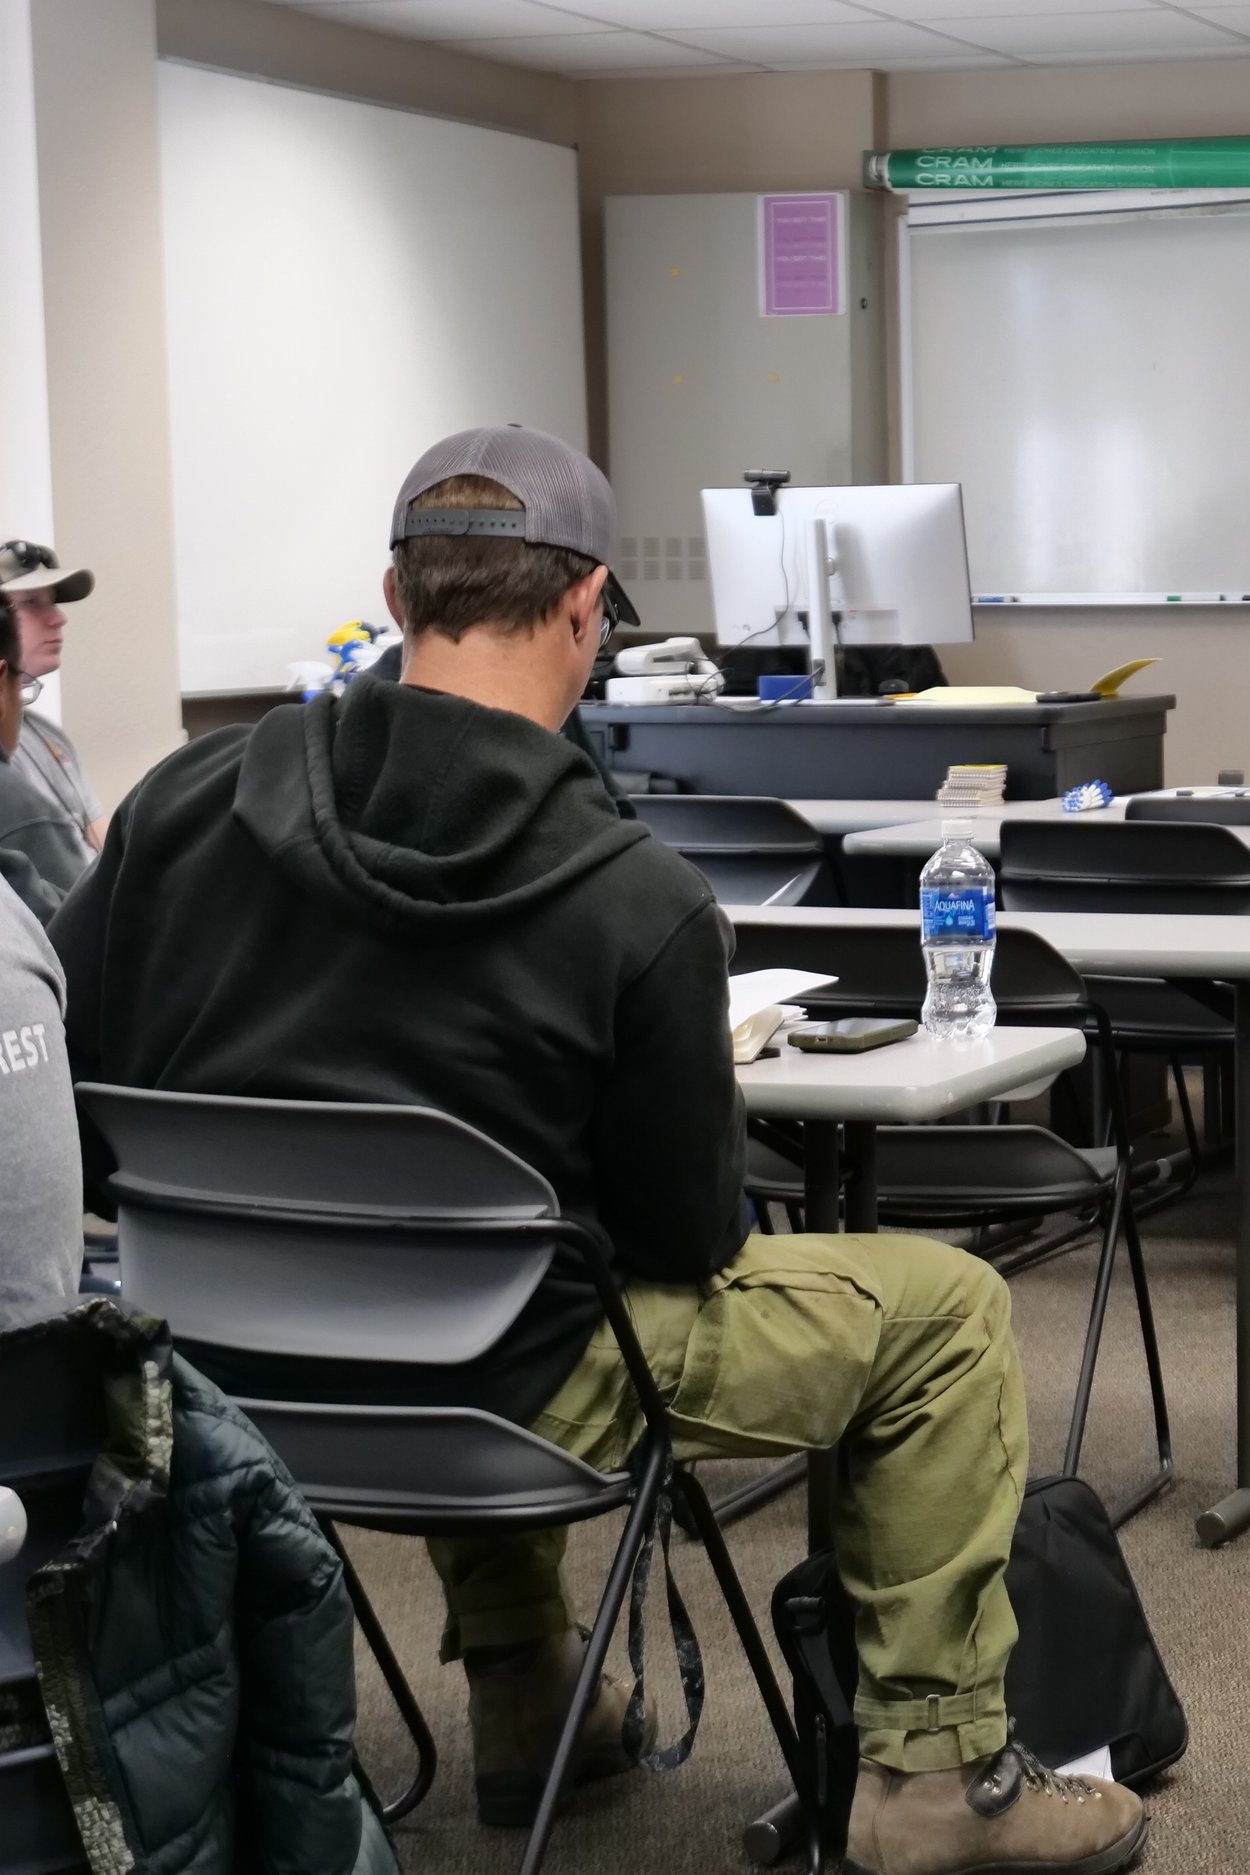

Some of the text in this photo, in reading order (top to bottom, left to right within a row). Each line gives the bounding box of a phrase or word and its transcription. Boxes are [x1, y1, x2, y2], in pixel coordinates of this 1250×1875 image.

[915, 155, 993, 169] CRAM
[915, 172, 994, 186] CRAM
[934, 899, 975, 913] AQUAFINA
